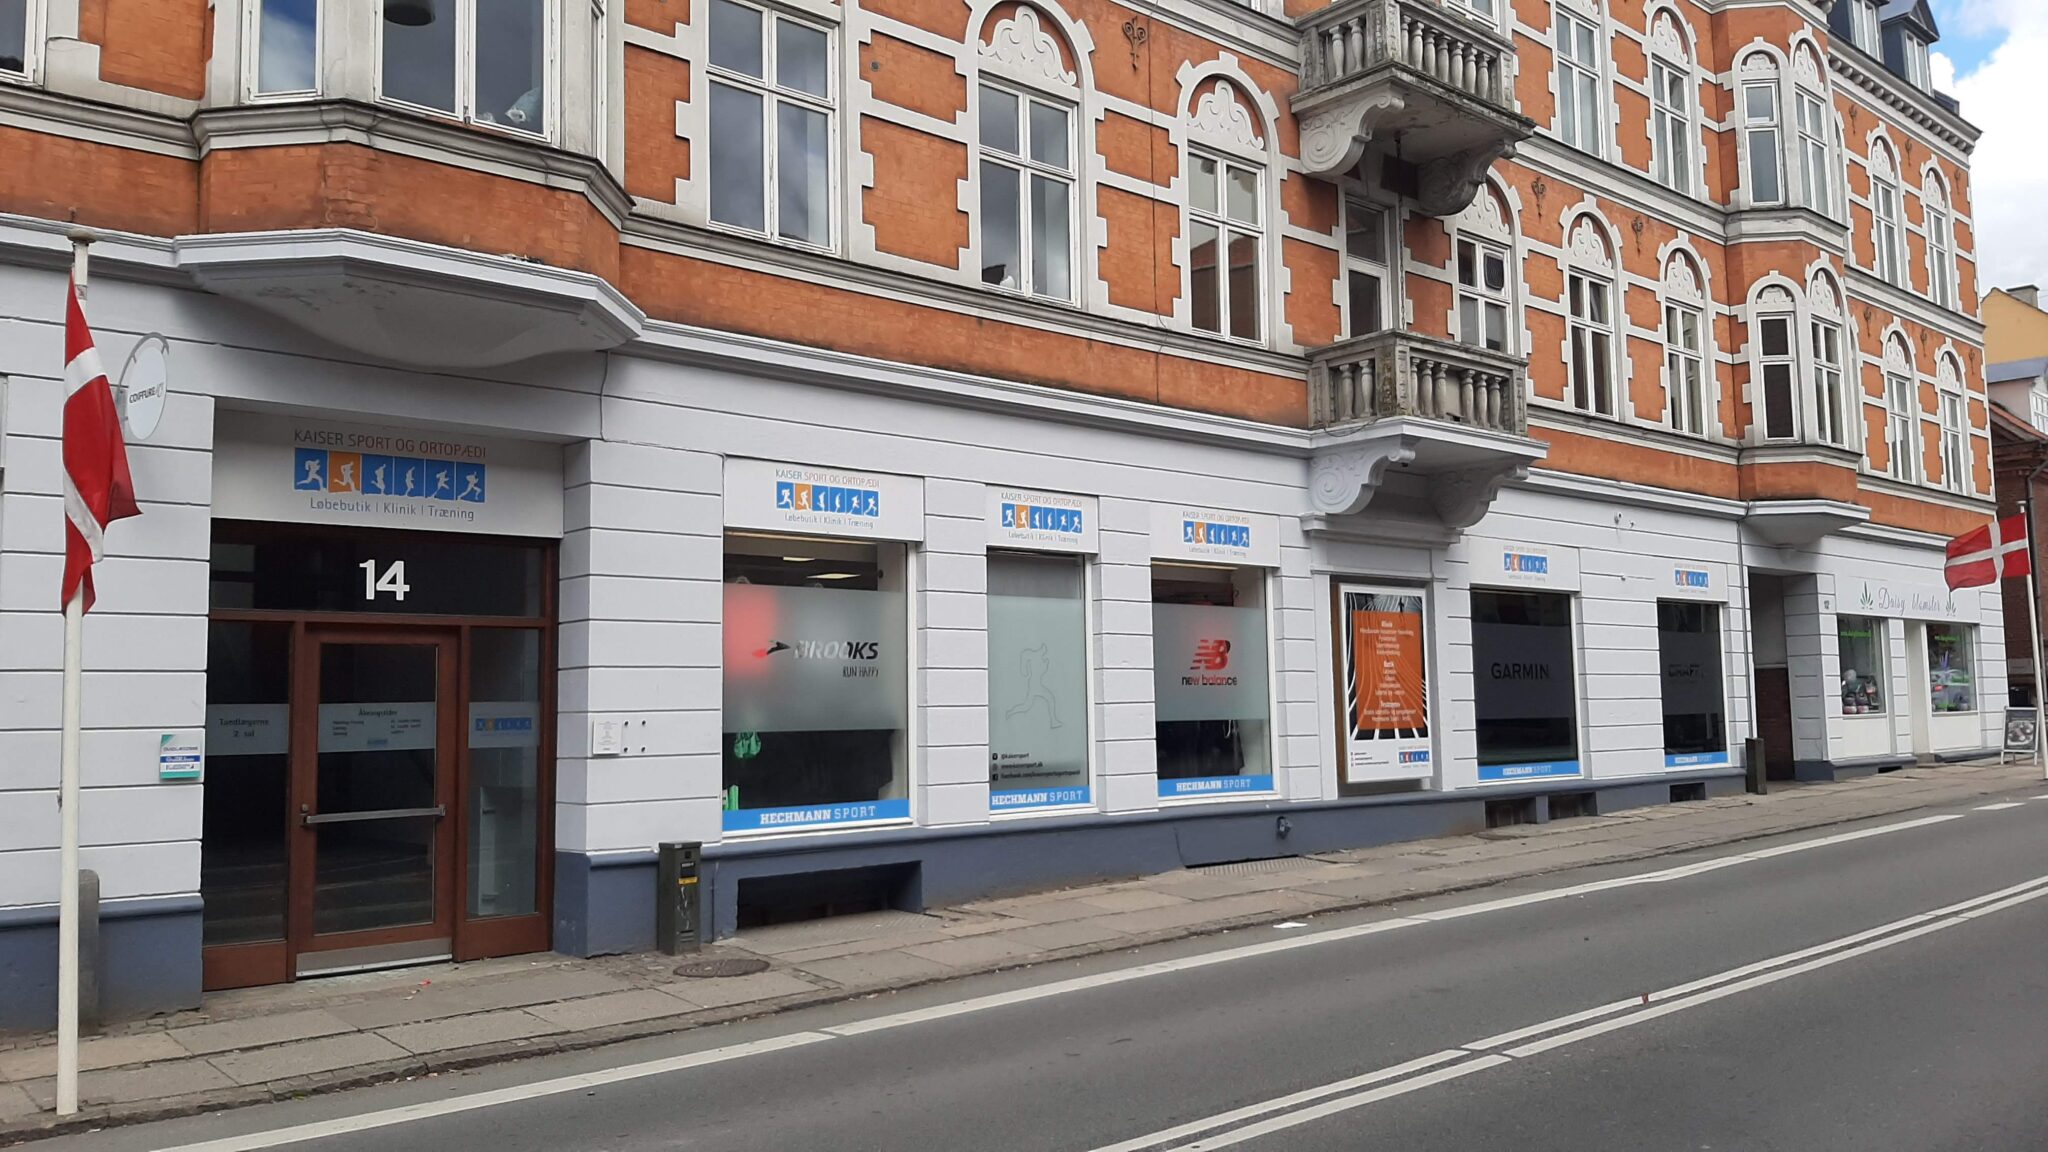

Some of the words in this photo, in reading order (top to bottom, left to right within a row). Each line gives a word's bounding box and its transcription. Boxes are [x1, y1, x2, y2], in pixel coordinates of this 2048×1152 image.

[294, 429, 344, 446] KAISER
[350, 433, 391, 449] SPORT
[395, 438, 415, 452] OG
[419, 440, 486, 458] ORTOPÆDI
[775, 468, 802, 479] KAISER
[804, 471, 827, 482] SPORT
[829, 474, 841, 484] OG
[842, 476, 880, 488] ORTOPÆDI
[1001, 491, 1022, 501] KAISER
[1023, 494, 1041, 503] SPORT
[310, 497, 371, 512] Løbebutik
[383, 502, 417, 515] Klinik
[428, 505, 475, 521] Træning
[784, 513, 817, 524] Løbebutik
[823, 517, 841, 525] Klinik
[848, 518, 874, 529] Træning
[359, 559, 410, 601] 14
[1878, 587, 1906, 617] Daisy
[794, 640, 879, 660] BROOKS
[842, 666, 858, 678] RUN
[859, 666, 879, 678] HAPPY
[1181, 676, 1200, 686] new
[1202, 674, 1238, 686] balance
[1490, 662, 1550, 680] GARMIN
[1175, 780, 1222, 792] HECHMANN
[1223, 778, 1251, 789] SPORT
[992, 791, 1048, 806] HECHMANN
[1049, 789, 1084, 802] SPORT
[760, 809, 832, 825] HECHMANN
[834, 805, 877, 820] SPORT
